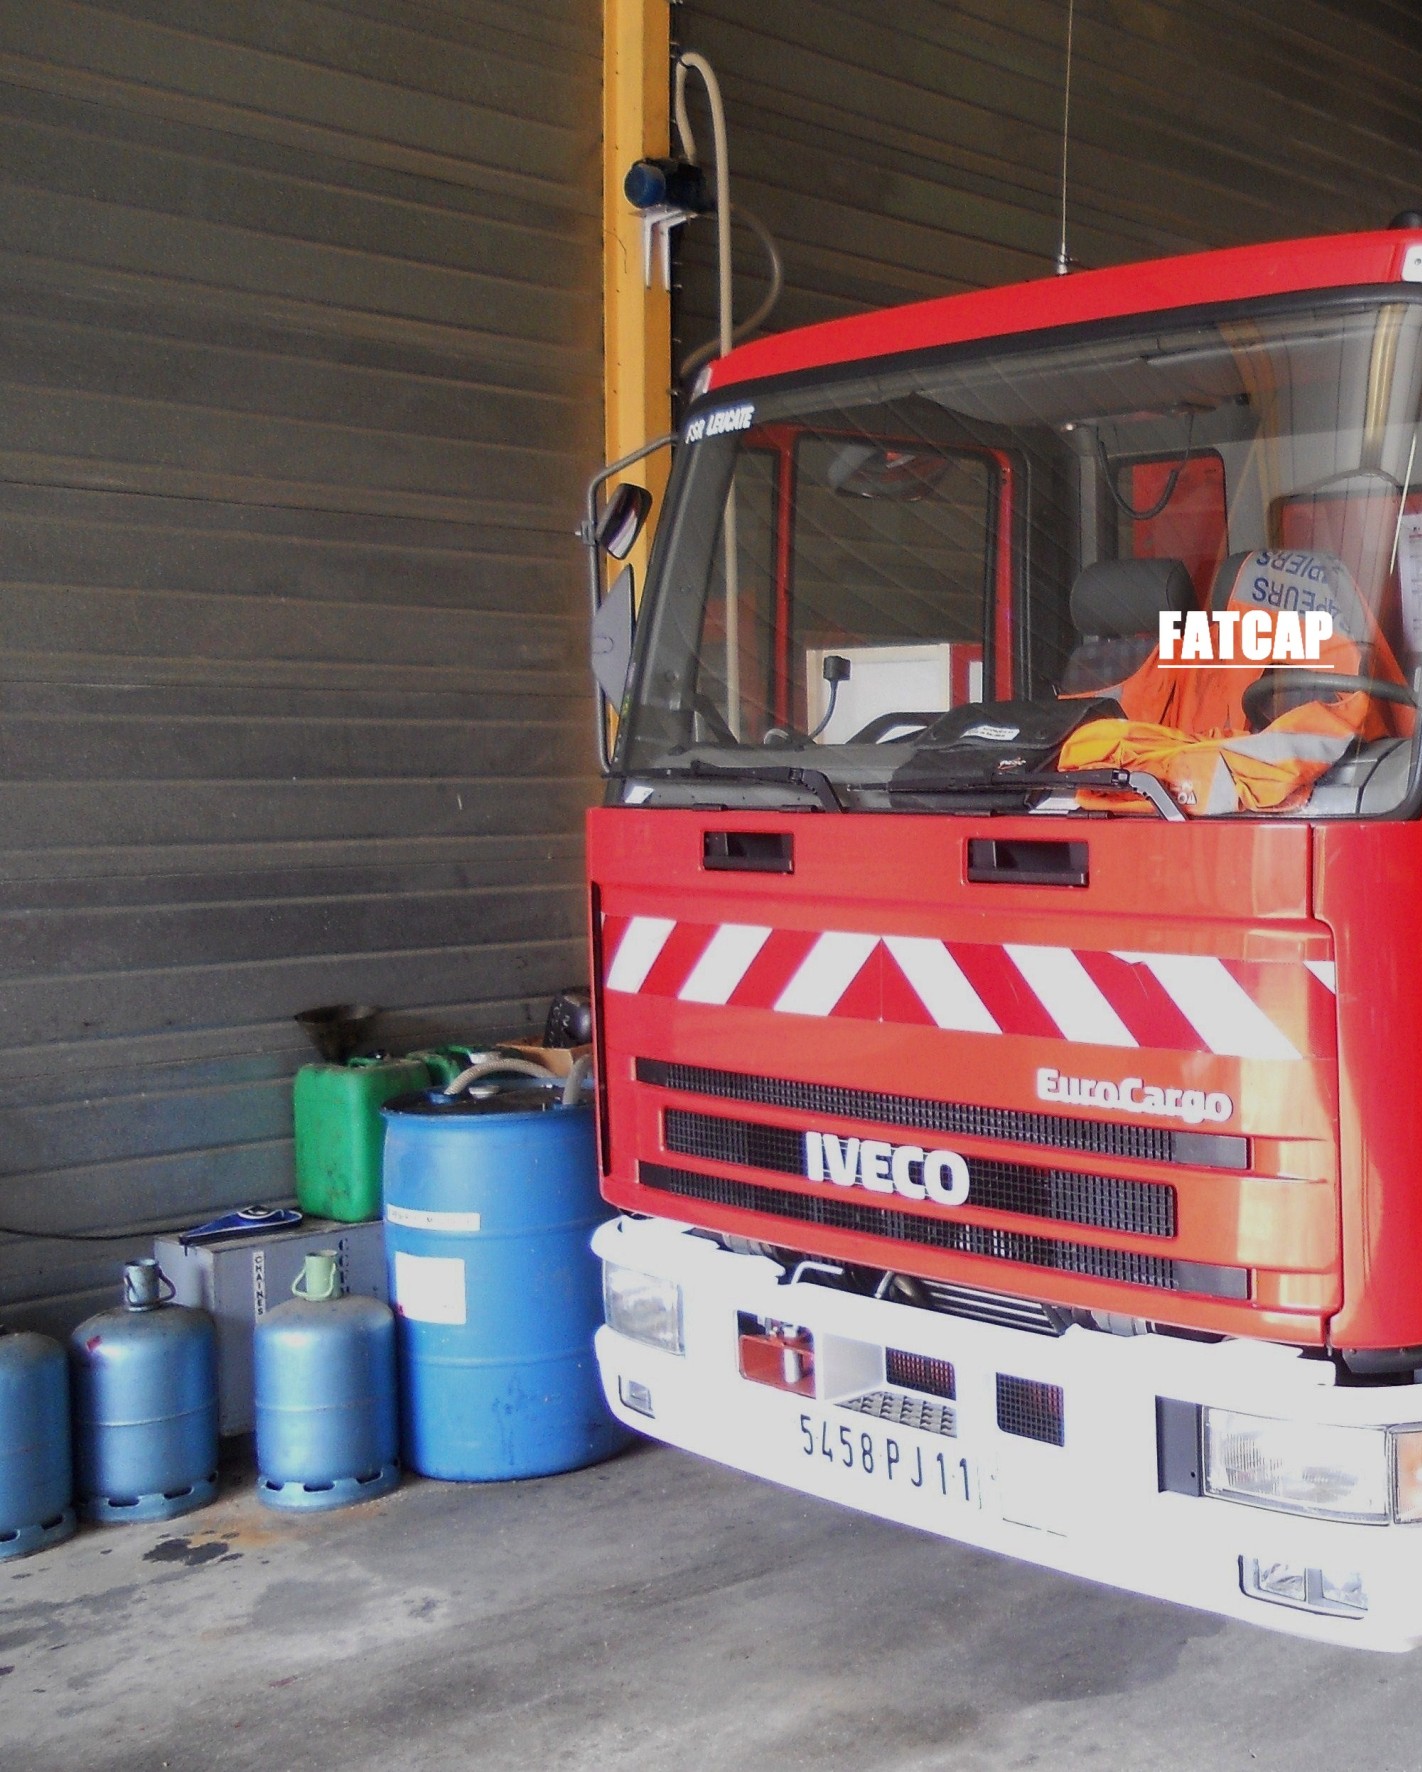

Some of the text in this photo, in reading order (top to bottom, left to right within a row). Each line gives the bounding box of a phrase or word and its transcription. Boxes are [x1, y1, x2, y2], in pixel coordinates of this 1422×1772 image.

[1037, 1067, 1235, 1123] EuroCargo
[805, 1131, 970, 1206] IVECO
[254, 1255, 264, 1315] CHAINES
[800, 1413, 874, 1474] 5458
